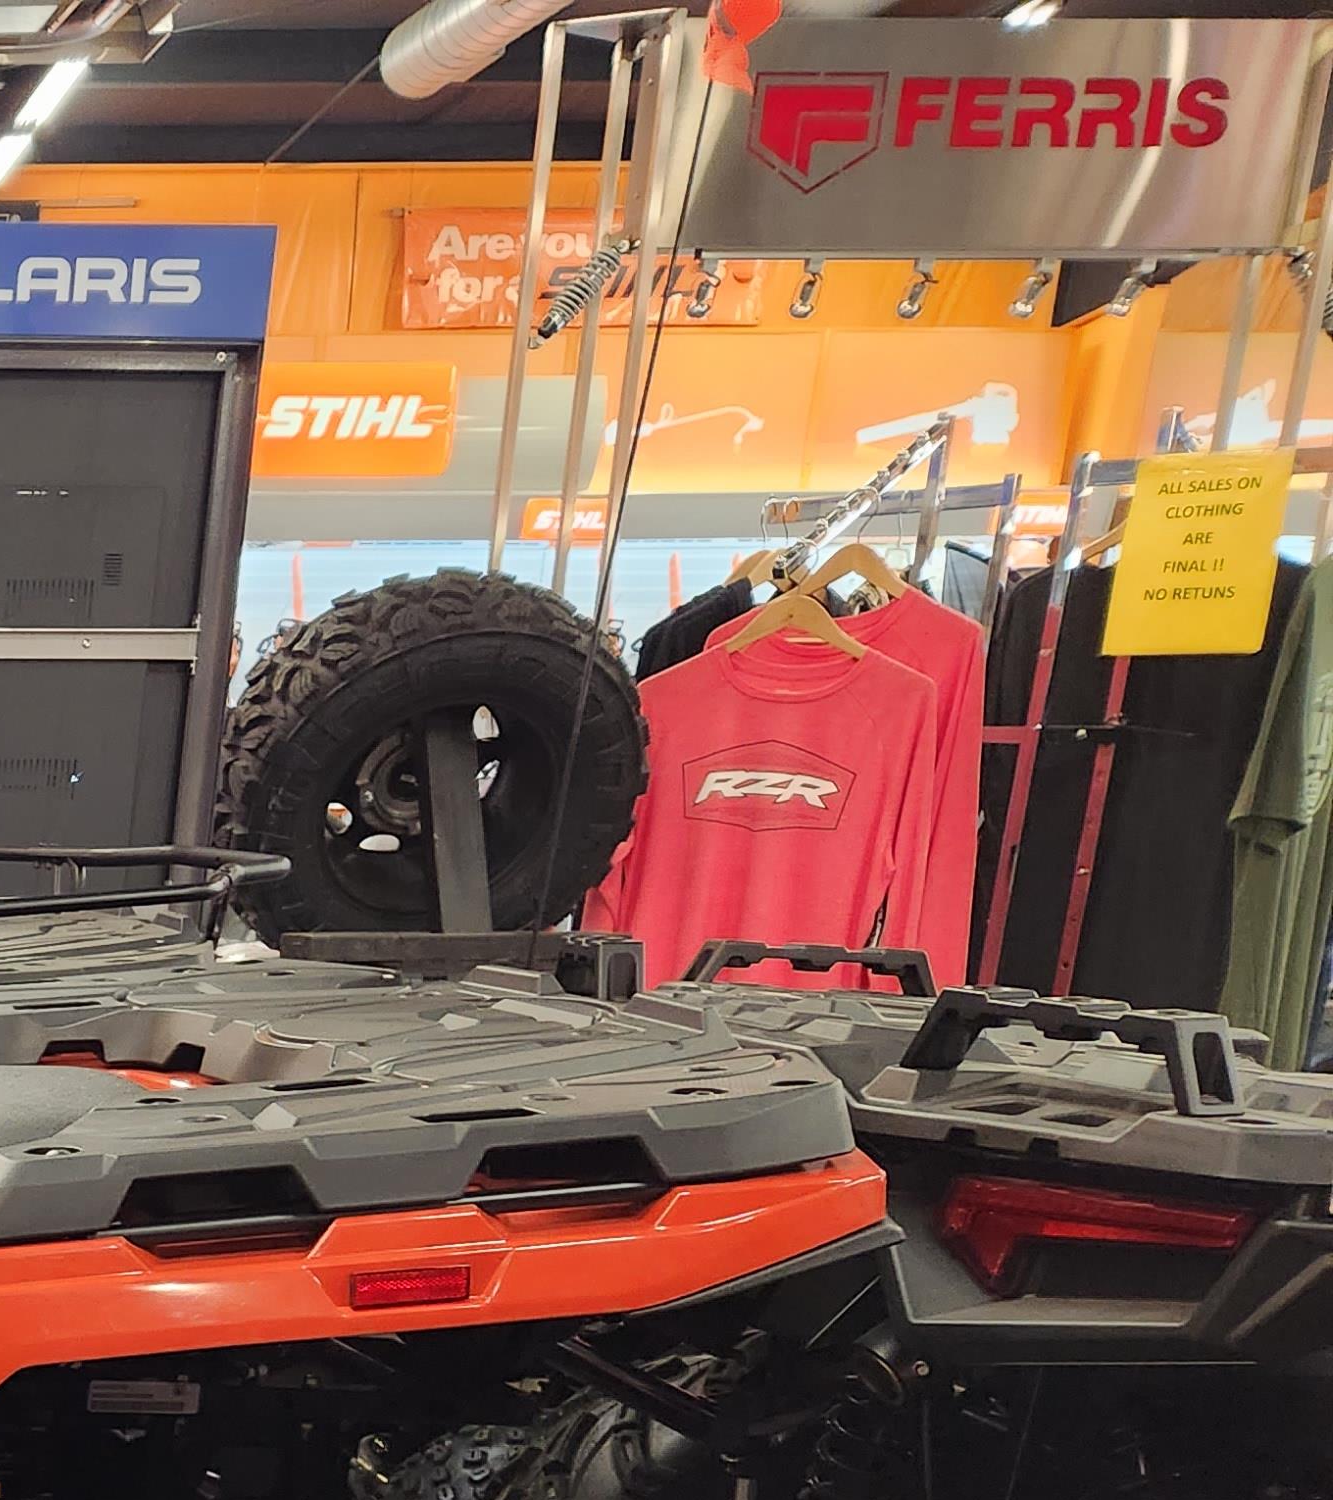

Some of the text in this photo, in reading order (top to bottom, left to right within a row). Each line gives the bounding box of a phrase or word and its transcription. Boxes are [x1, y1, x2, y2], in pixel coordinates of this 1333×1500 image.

[894, 77, 1229, 149] FERRIS
[427, 226, 594, 262] Are ou
[436, 267, 503, 304] for
[262, 395, 433, 440] STIHL
[1158, 476, 1262, 496] ALL SALES ON
[1165, 502, 1244, 519] CLOTHING
[1182, 532, 1213, 546] ARE
[1163, 560, 1208, 574] FINAL
[1144, 586, 1236, 601] NO RETUNS
[693, 768, 840, 810] RZR
